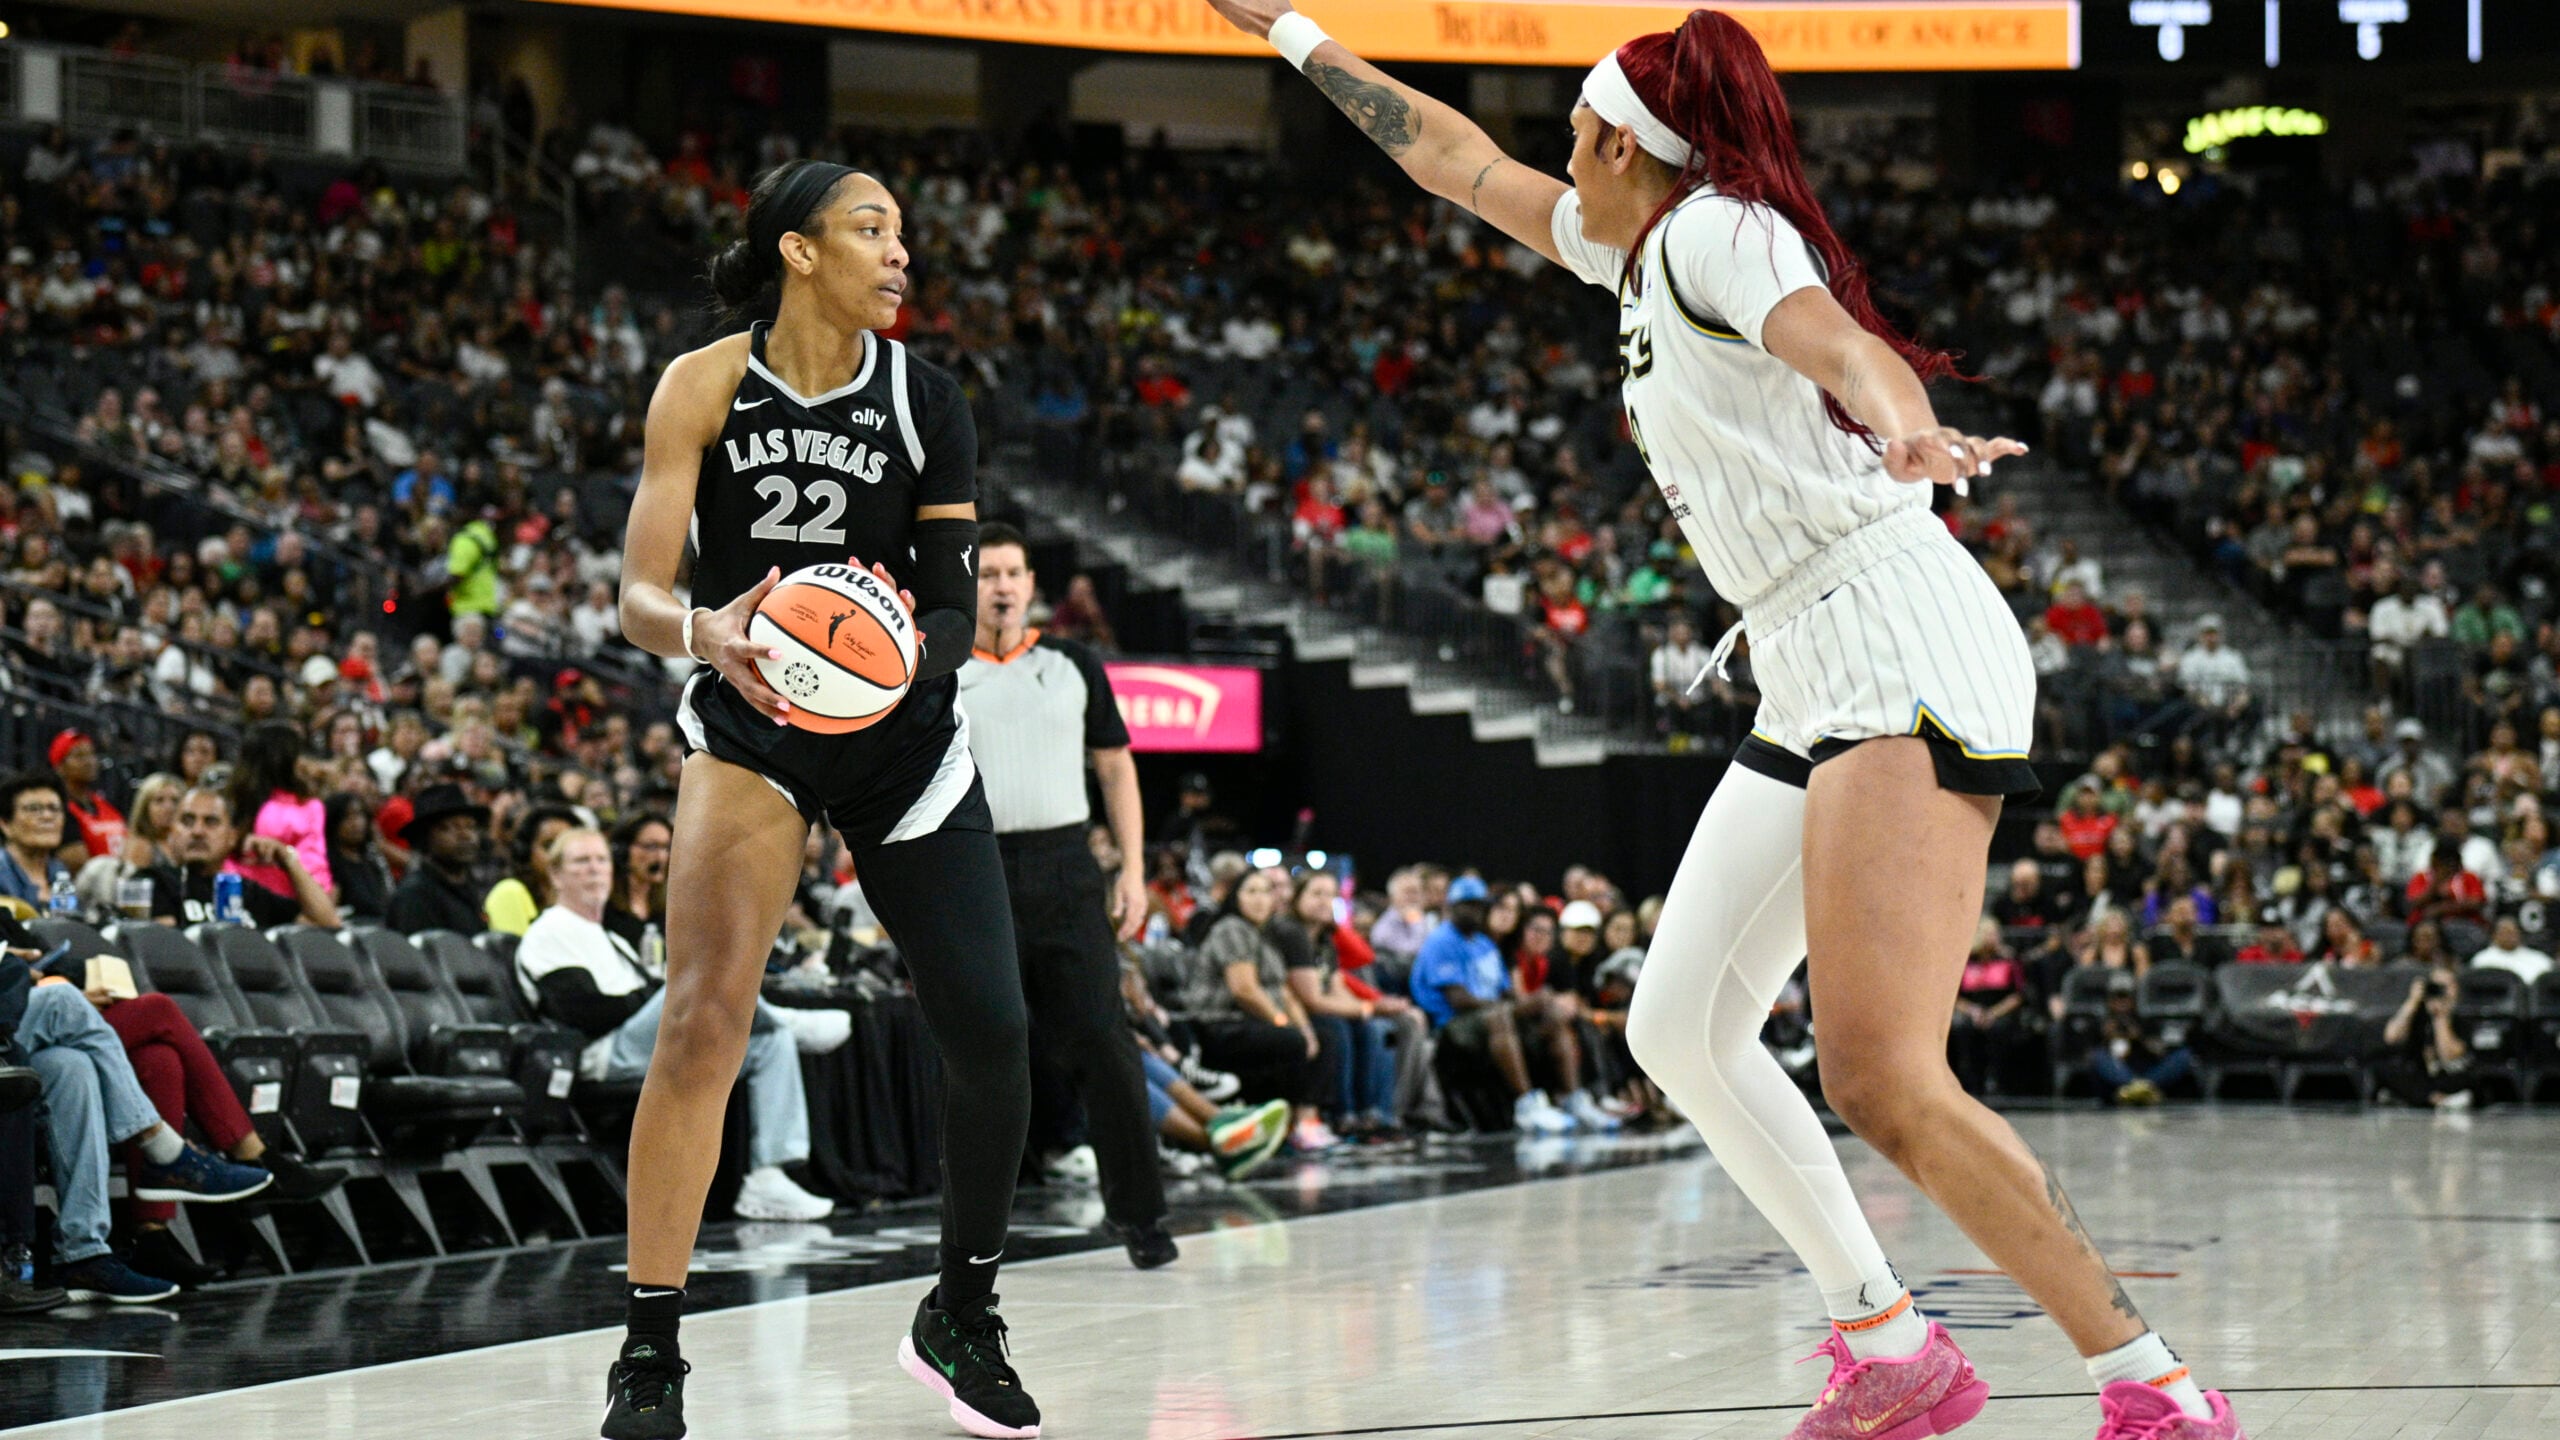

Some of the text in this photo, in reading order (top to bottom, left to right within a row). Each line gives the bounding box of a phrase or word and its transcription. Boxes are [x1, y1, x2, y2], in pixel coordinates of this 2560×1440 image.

[1074, 0, 1232, 36] TEQUI
[851, 408, 887, 430] ally
[725, 429, 889, 484] LAS VEGAS
[751, 474, 847, 545] 22
[813, 566, 905, 633] Wilson
